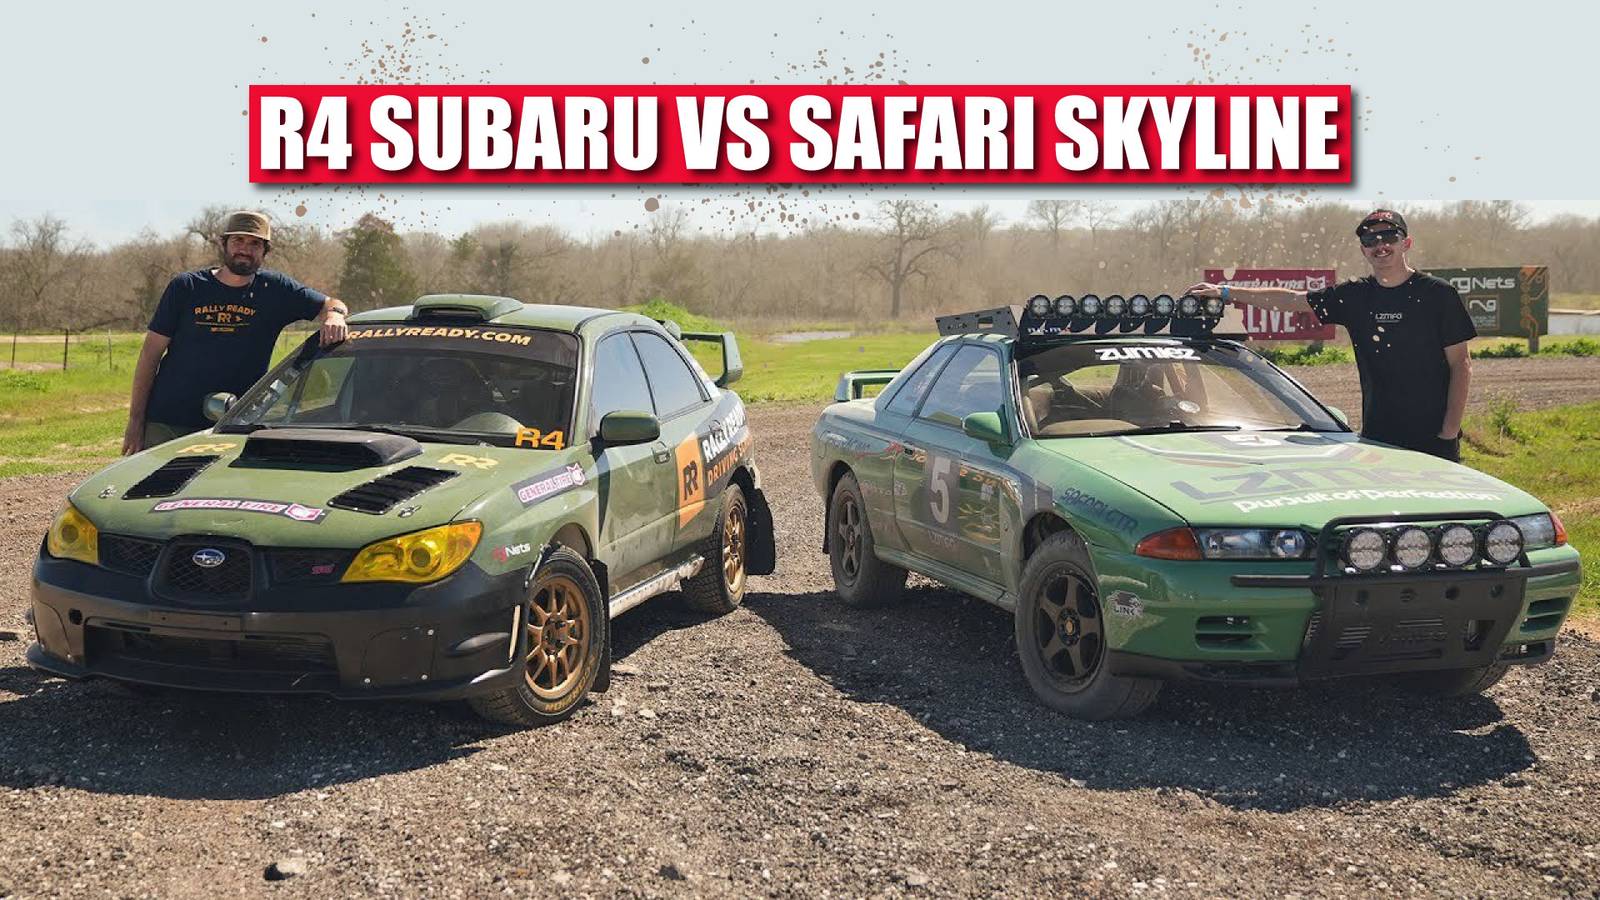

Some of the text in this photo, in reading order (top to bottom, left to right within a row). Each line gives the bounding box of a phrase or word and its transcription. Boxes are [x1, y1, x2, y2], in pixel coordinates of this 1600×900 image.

[194, 304, 256, 316] RALLY READY
[1247, 304, 1297, 333] LIVE
[345, 327, 532, 346] RALLYREADY.COM
[515, 427, 566, 451] R4
[518, 477, 557, 503] GENERAL
[930, 456, 950, 524] 5
[155, 500, 287, 513] GENERAL TIRE
